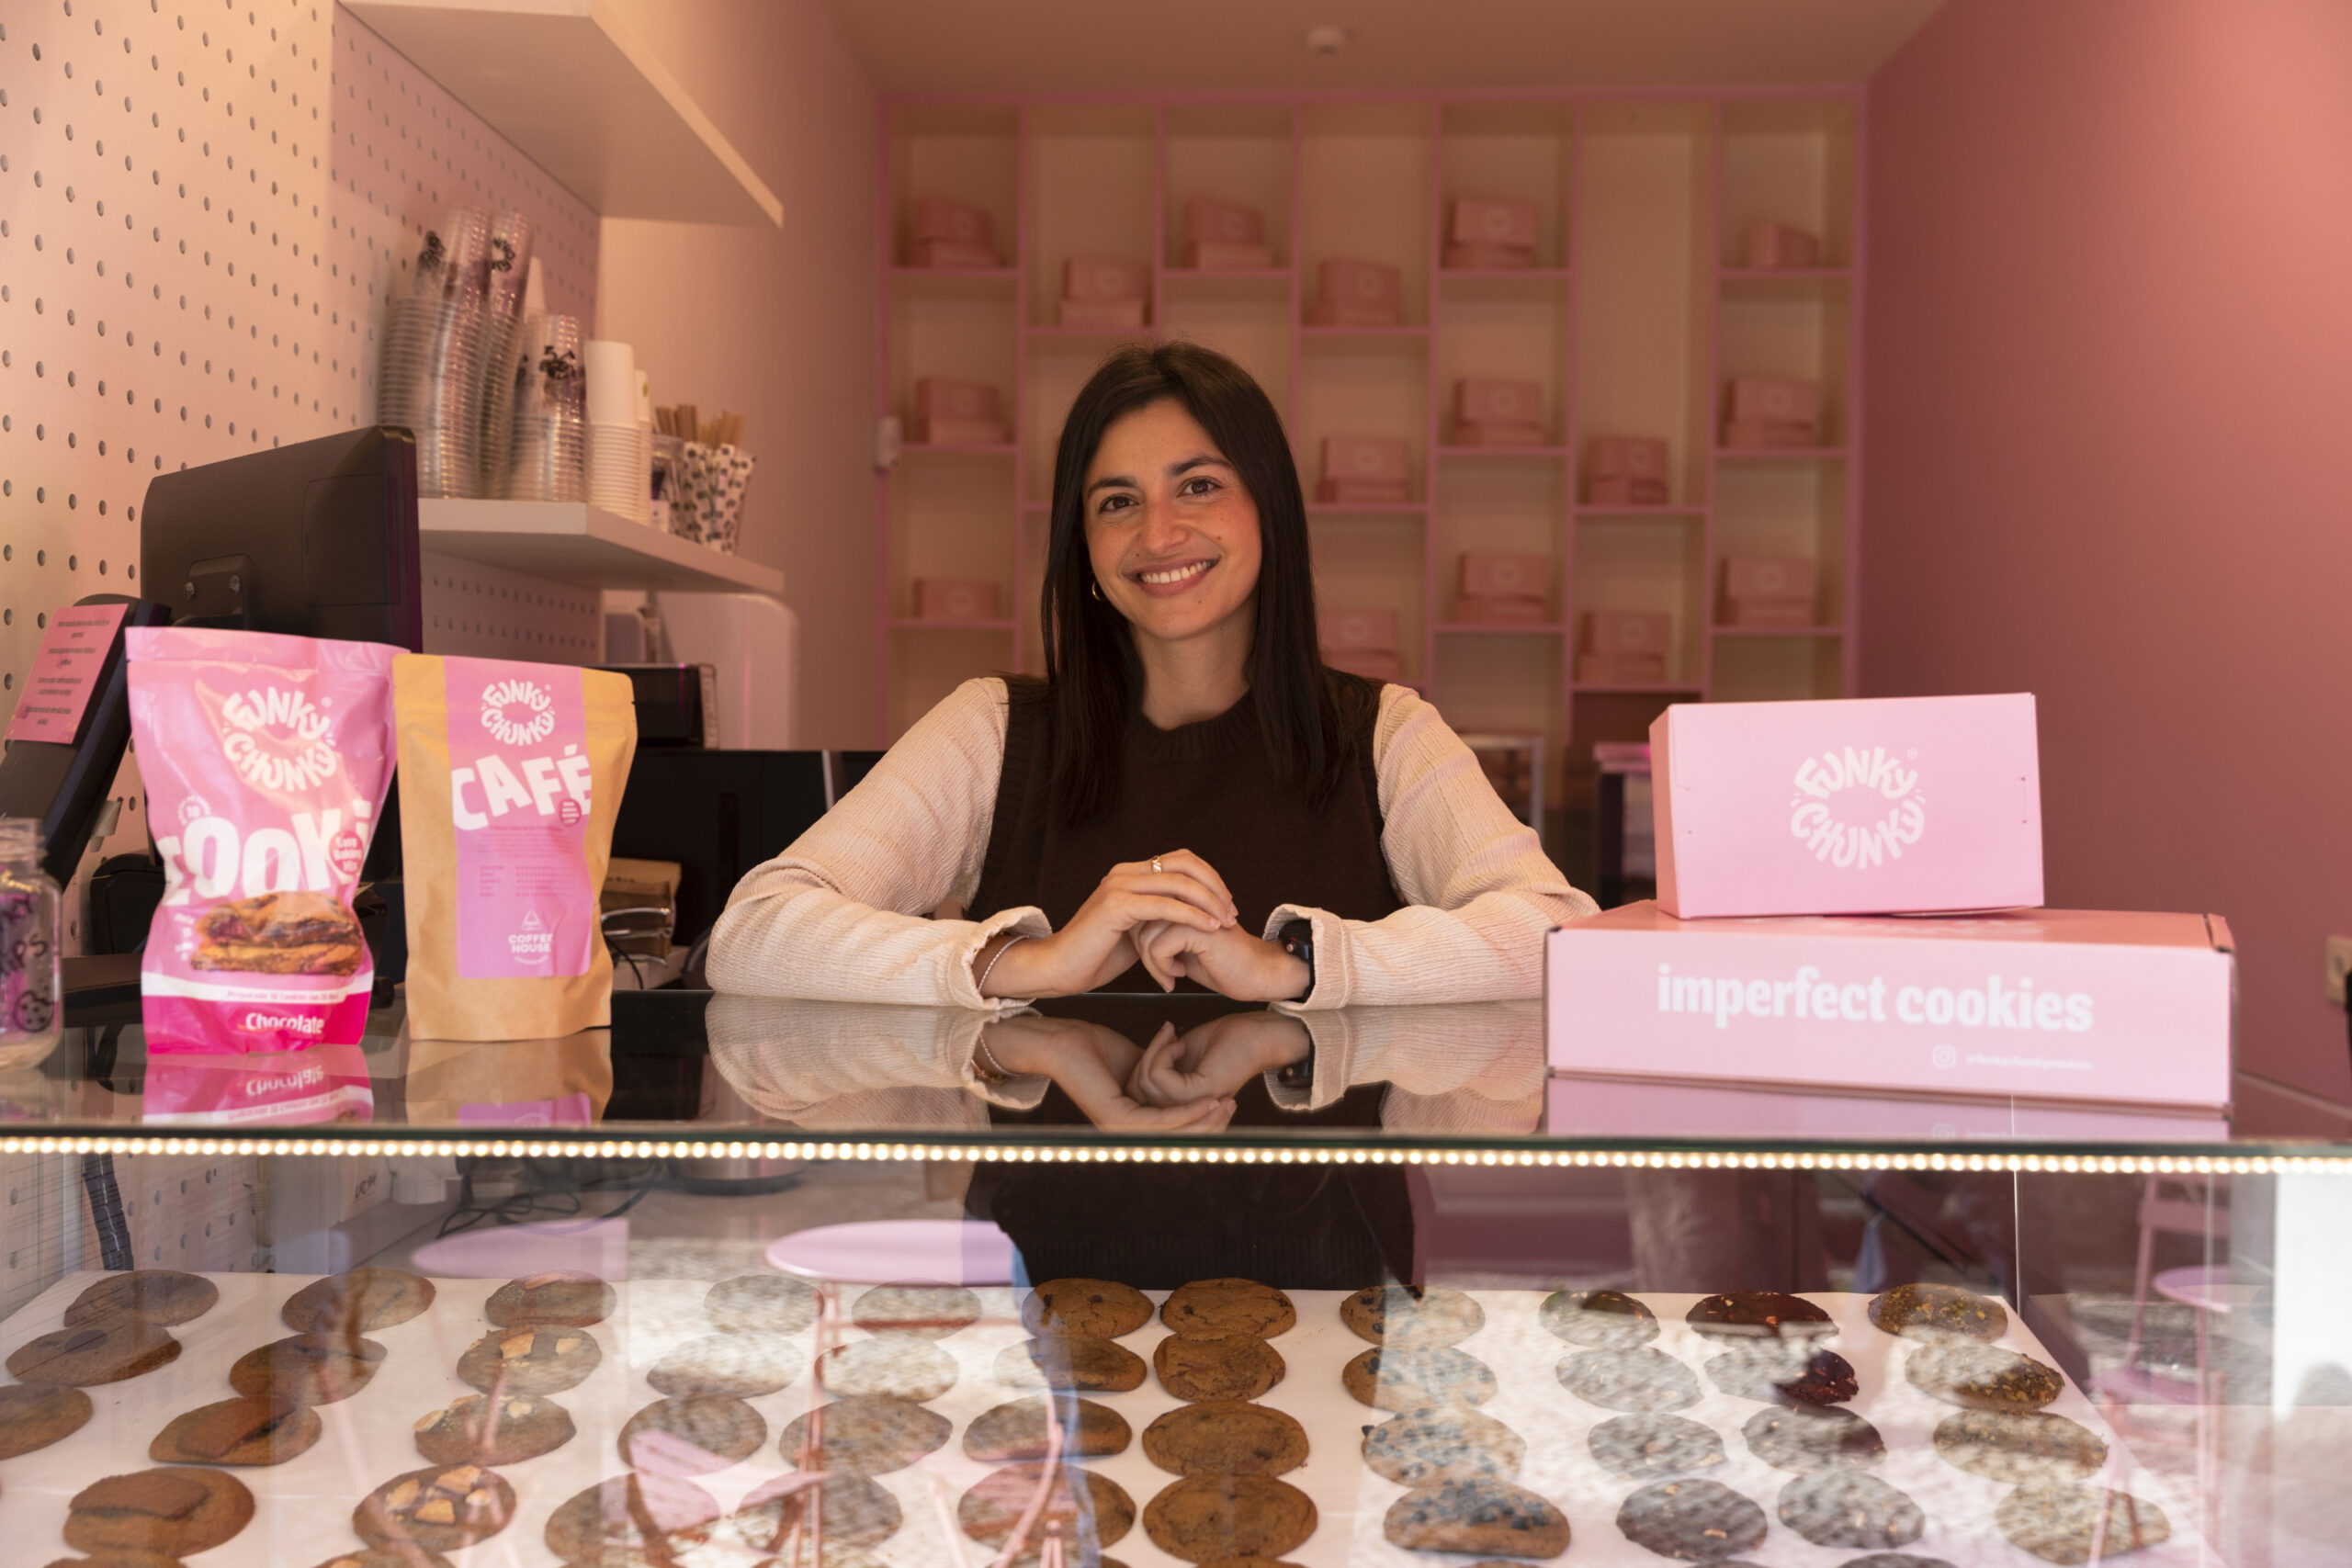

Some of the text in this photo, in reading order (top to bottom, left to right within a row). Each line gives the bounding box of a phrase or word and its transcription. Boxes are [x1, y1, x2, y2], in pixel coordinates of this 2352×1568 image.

[222, 686, 331, 739] FUNKY
[482, 679, 551, 712] FUNKY
[481, 708, 555, 746] CHUNKY
[223, 733, 336, 792] CHUNKY
[451, 744, 591, 830] CAFÉ
[1794, 746, 1918, 799] FUNKY
[1791, 800, 1925, 870] CHUNKY
[511, 943, 551, 953] HOUSE
[245, 1012, 324, 1034] Chocolate
[1657, 964, 2094, 1032] imperfect cookies
